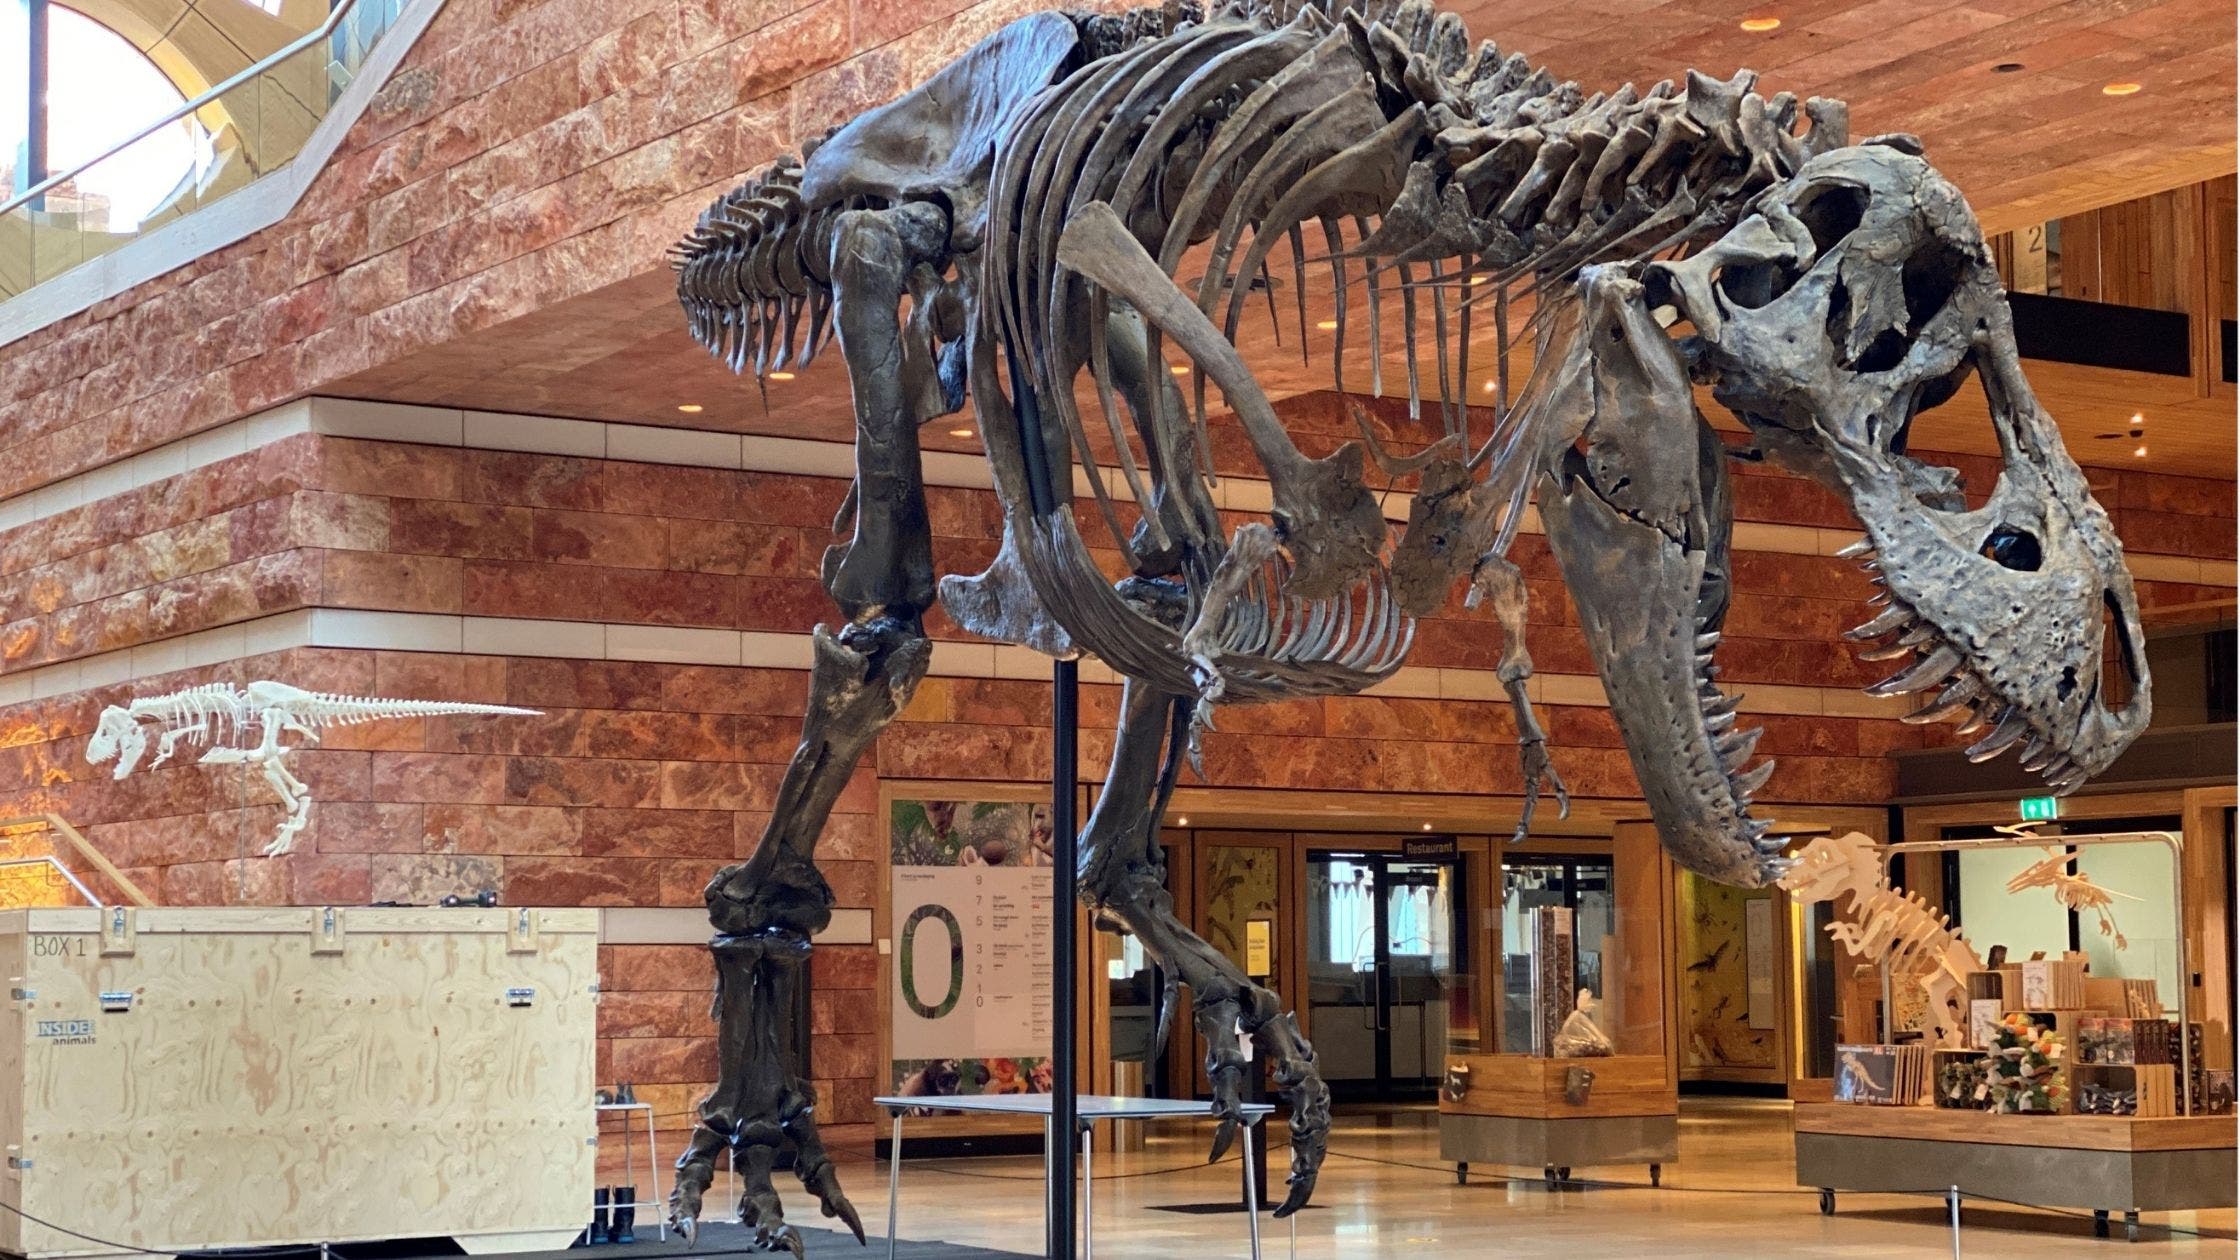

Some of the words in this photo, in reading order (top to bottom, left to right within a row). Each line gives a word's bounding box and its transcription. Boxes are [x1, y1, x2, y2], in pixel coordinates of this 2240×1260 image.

[2029, 225, 2042, 253] 2
[1407, 842, 1453, 855] Restaurant
[975, 874, 983, 886] 9
[975, 895, 983, 907] 7
[34, 935, 70, 957] BOX
[76, 938, 87, 957] 1
[976, 943, 983, 955] 3
[900, 904, 963, 1019] 0
[976, 963, 983, 975] 2
[976, 995, 984, 1008] 0
[37, 1020, 90, 1036] INSIDE
[53, 1036, 97, 1046] animals
